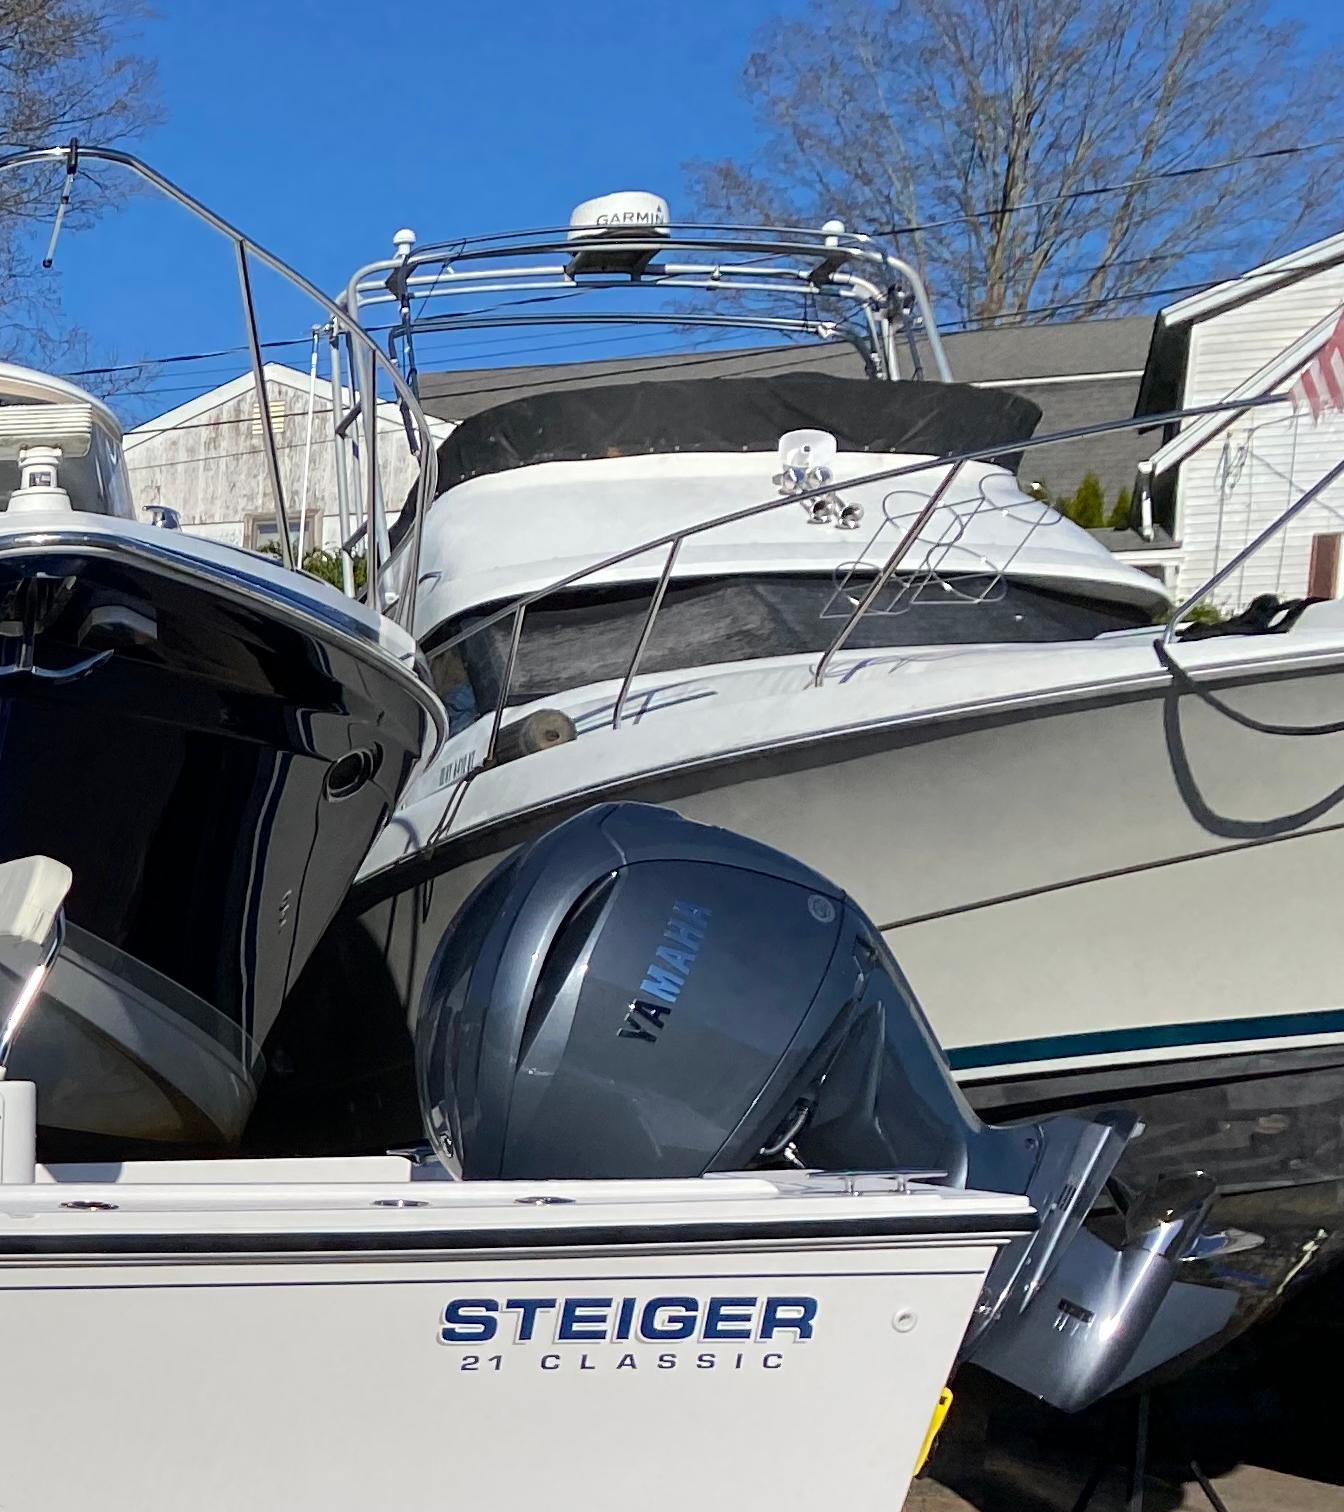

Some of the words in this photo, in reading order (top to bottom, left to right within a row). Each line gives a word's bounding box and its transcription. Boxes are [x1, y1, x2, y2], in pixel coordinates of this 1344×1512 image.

[597, 212, 664, 227] GARMIN
[616, 901, 712, 1043] YAMAHA
[440, 1296, 820, 1343] STEIGER
[460, 1354, 503, 1371] 21
[540, 1352, 784, 1371] CLASSIC
